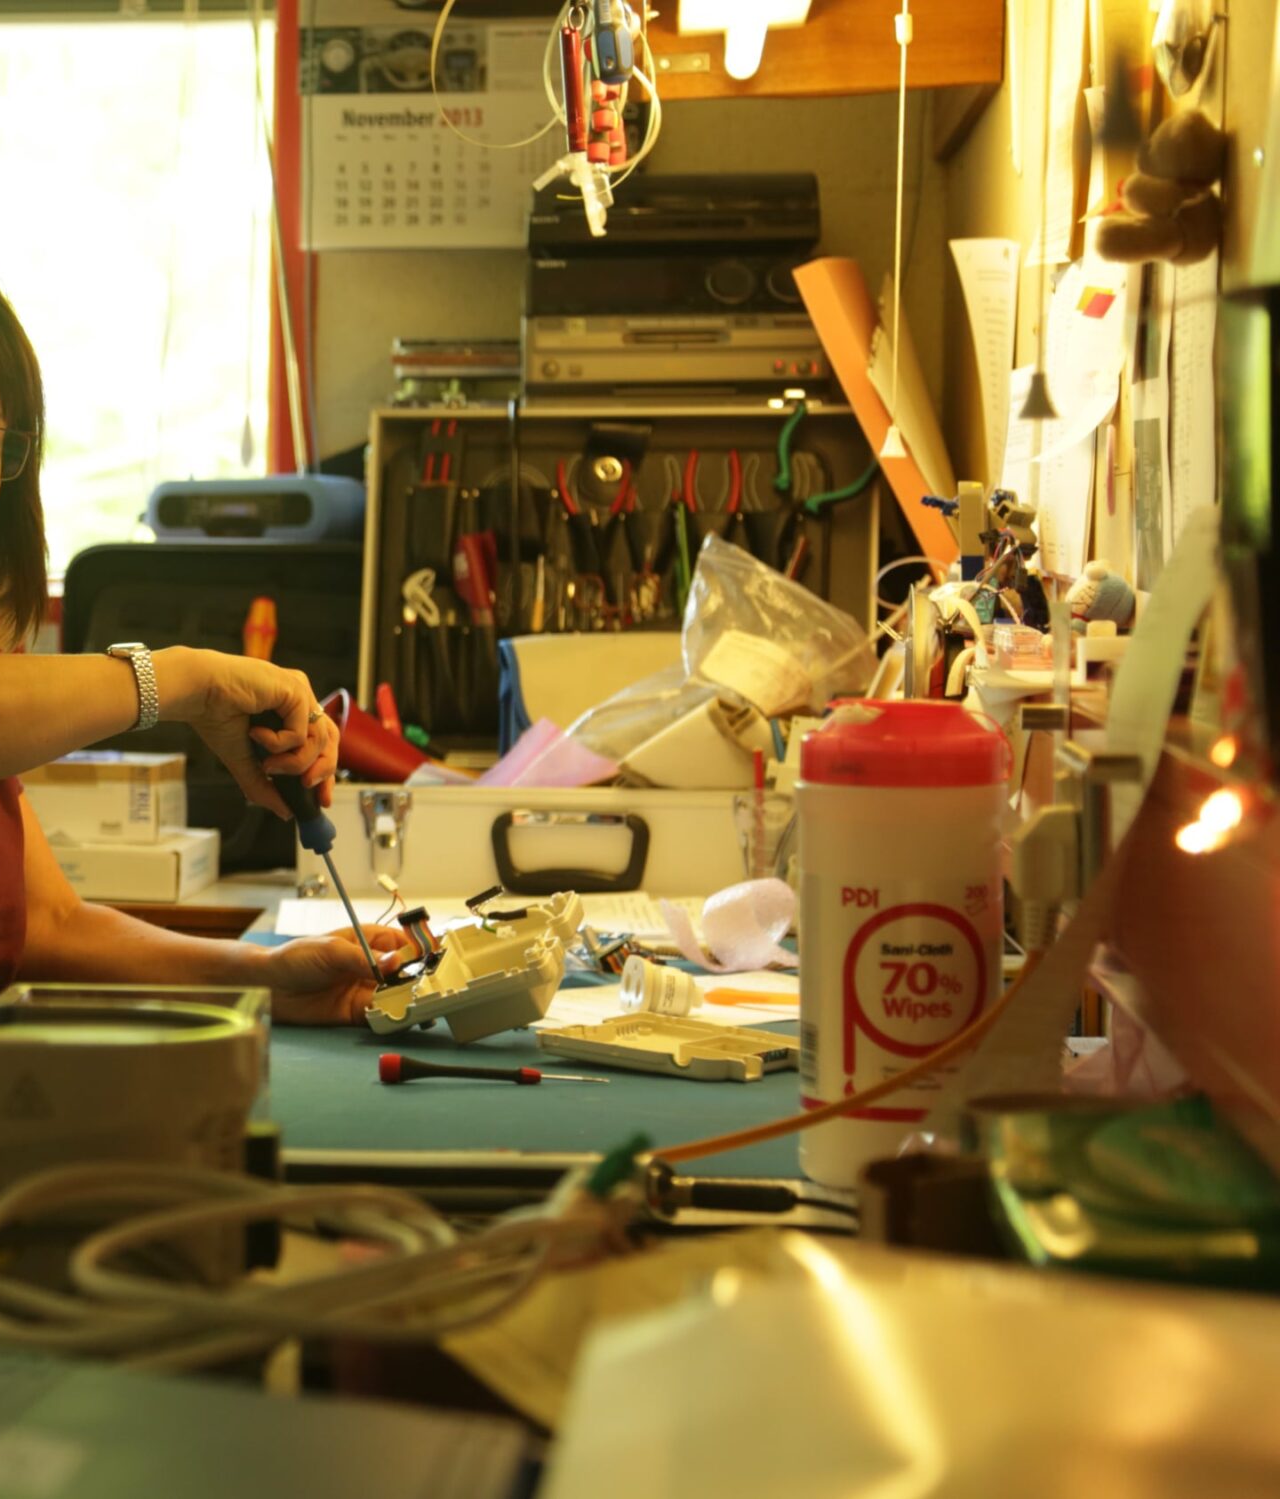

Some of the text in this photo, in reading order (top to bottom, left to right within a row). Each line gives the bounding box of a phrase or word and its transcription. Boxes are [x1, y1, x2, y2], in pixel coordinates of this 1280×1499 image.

[342, 107, 483, 127] November 2013
[841, 886, 880, 909] PDI
[880, 943, 954, 957] Sani-Cloth
[879, 961, 963, 996] 70%
[881, 998, 953, 1022] Wipes
